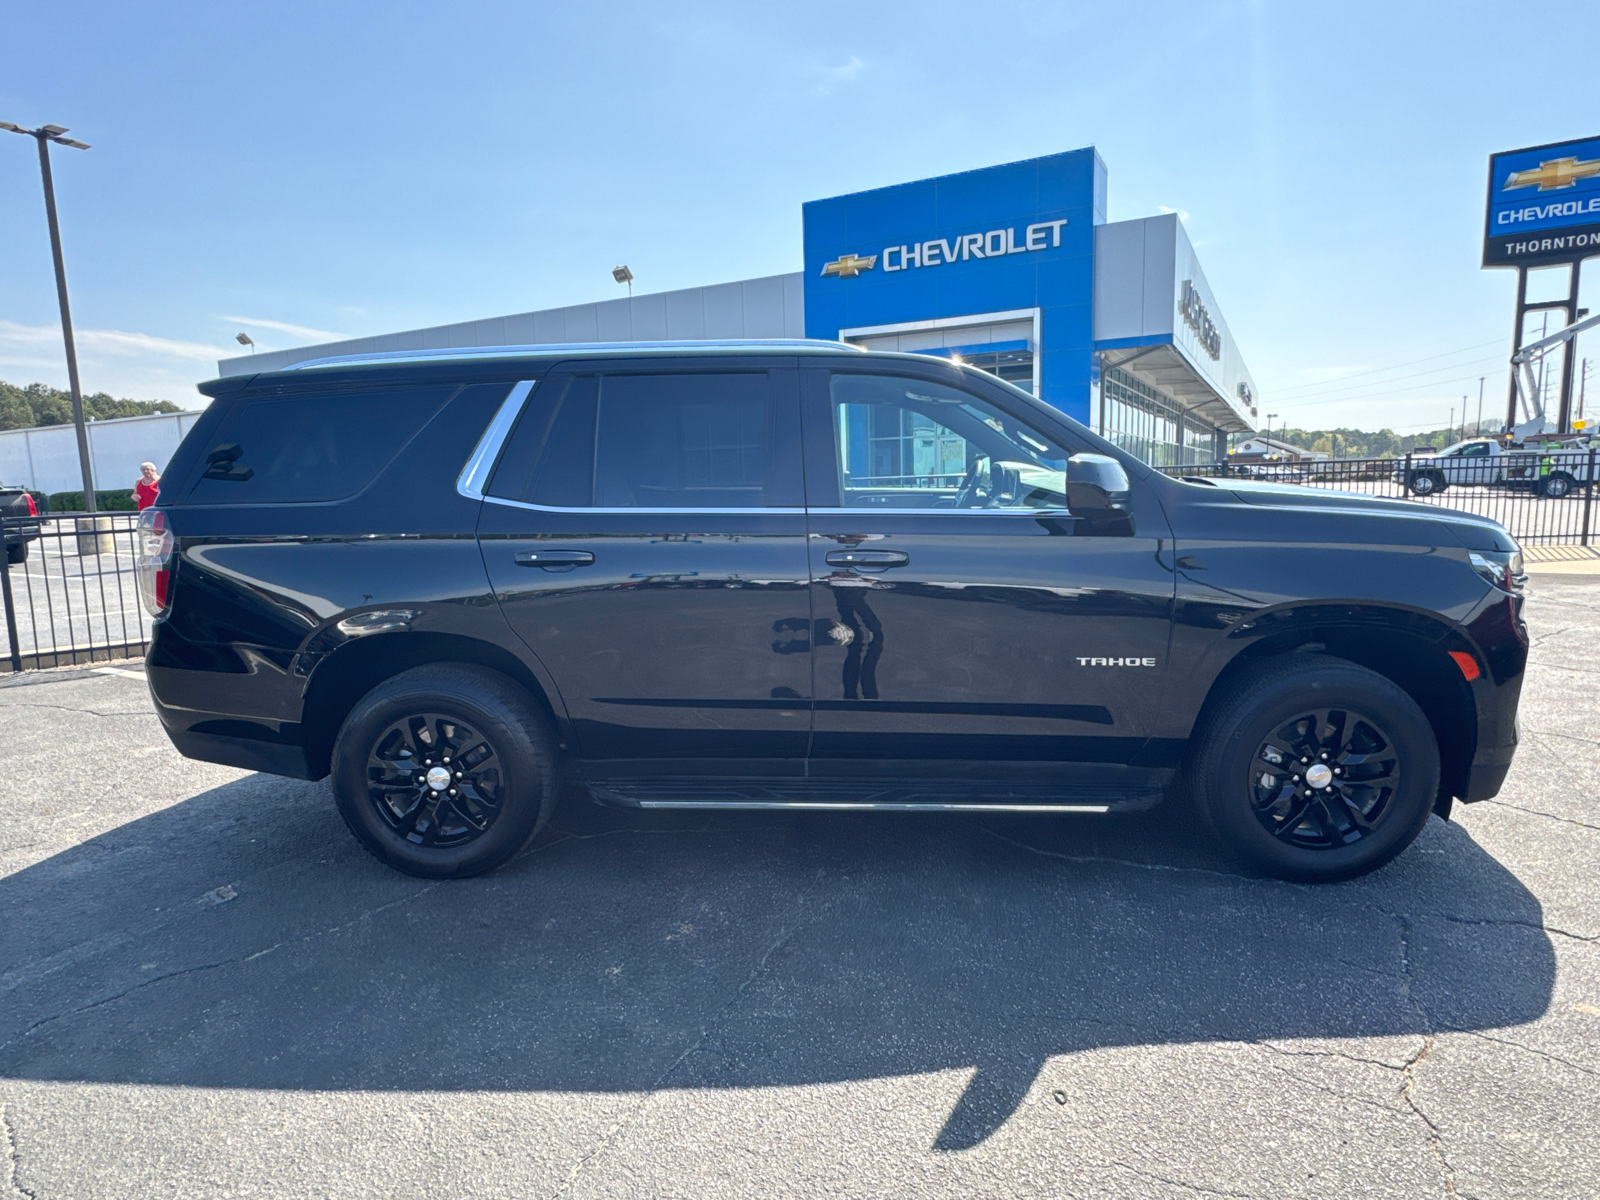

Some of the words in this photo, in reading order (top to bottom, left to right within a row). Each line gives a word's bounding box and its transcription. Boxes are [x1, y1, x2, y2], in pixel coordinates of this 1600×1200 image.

[883, 219, 1067, 272] CHEVROLET
[1505, 232, 1600, 254] THORNTON
[1076, 657, 1156, 667] TAHOE
